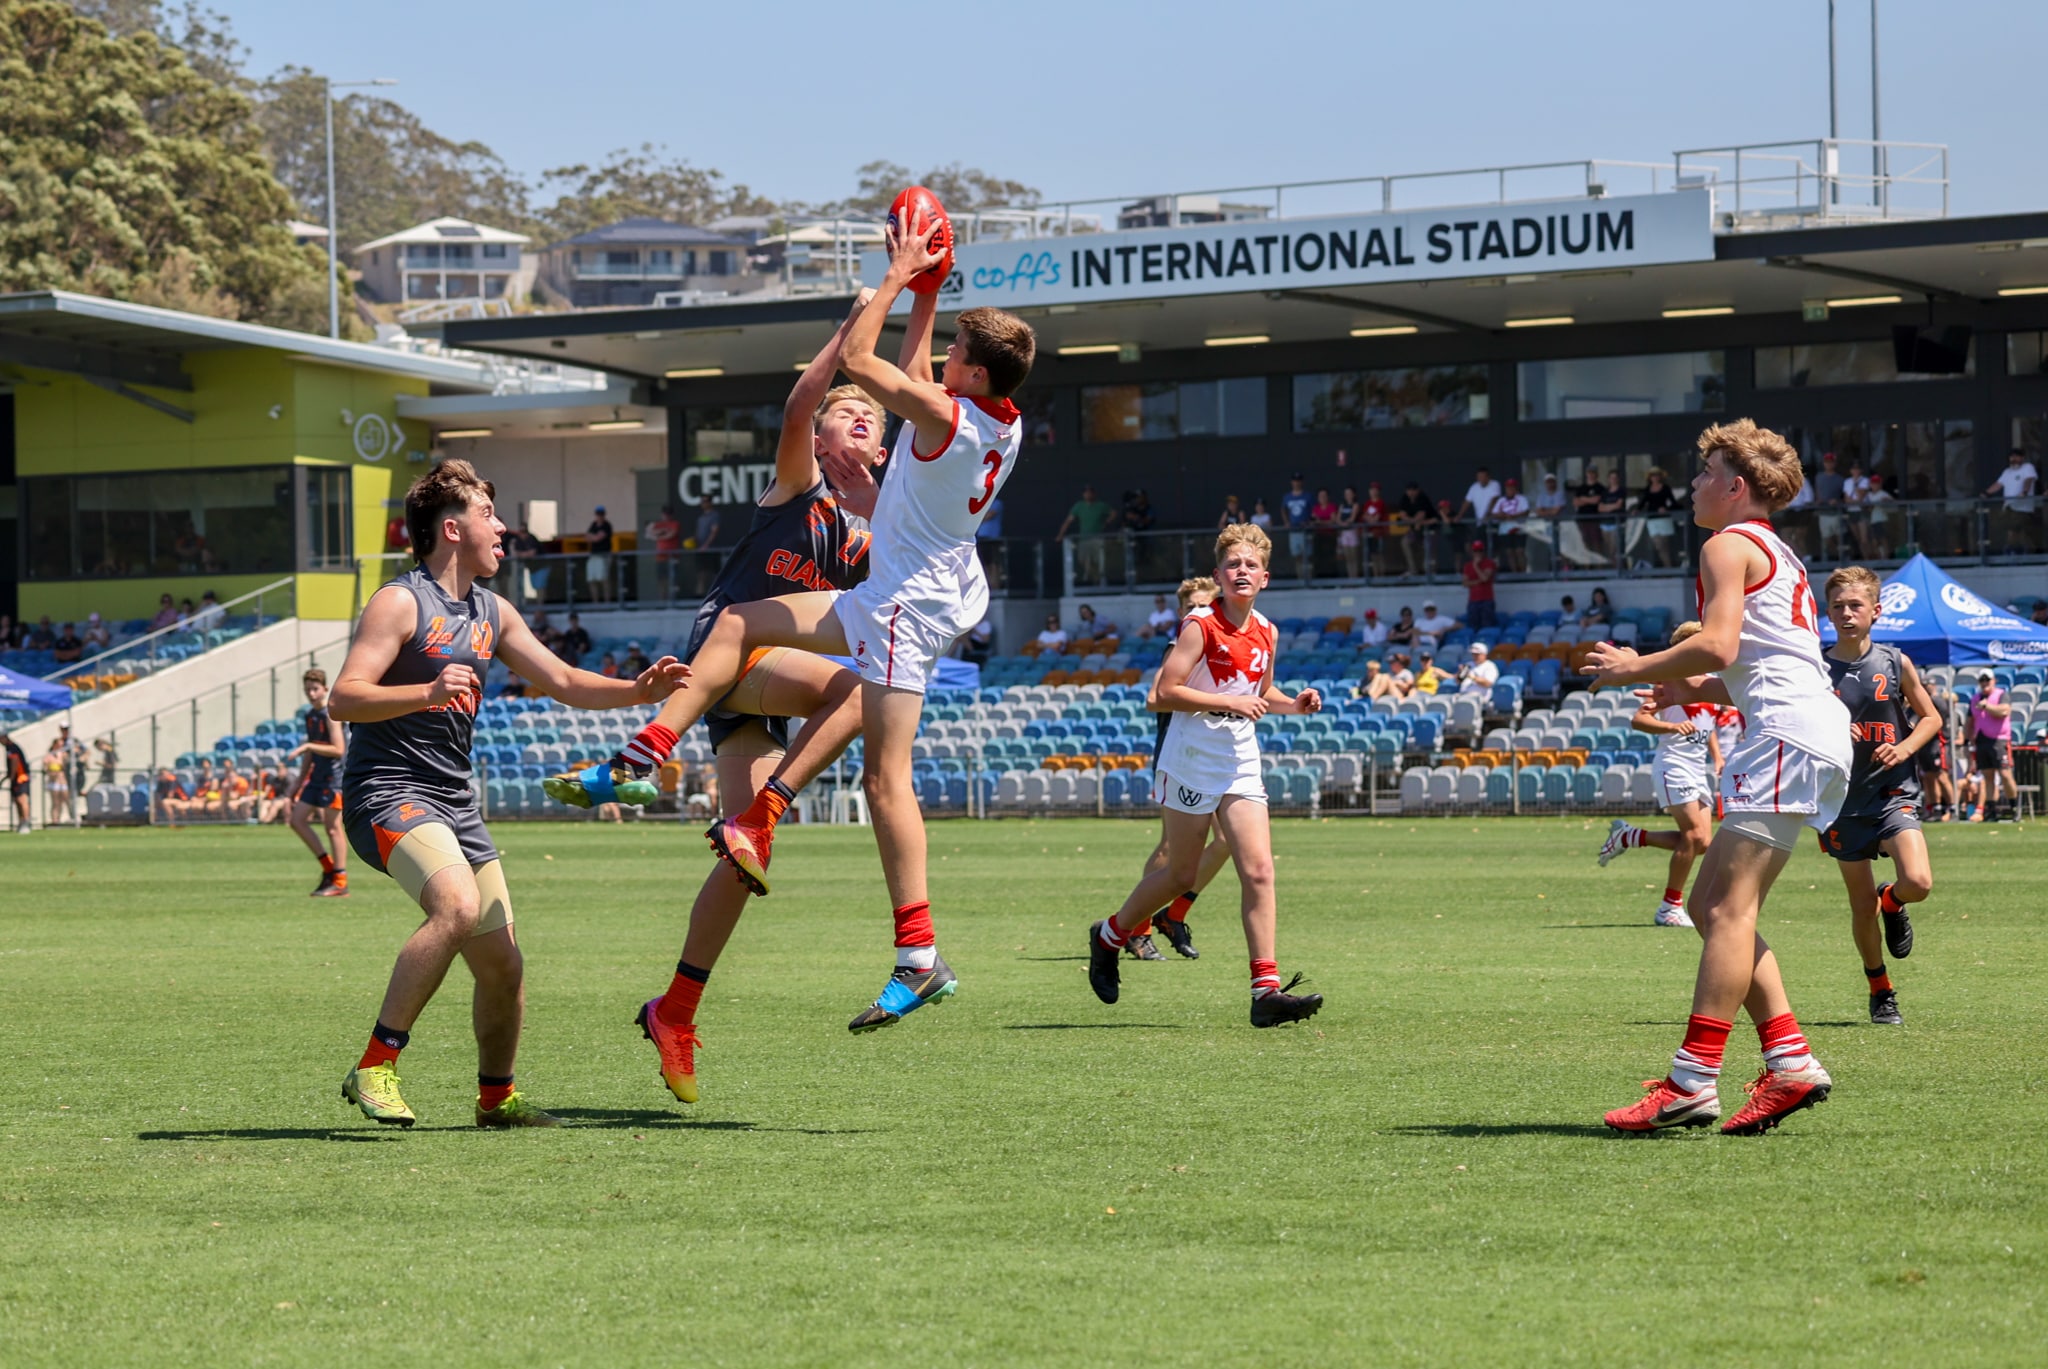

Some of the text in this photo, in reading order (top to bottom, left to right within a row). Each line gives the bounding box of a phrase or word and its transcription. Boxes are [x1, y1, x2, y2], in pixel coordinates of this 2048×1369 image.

[973, 251, 1062, 293] coffs
[1072, 226, 1414, 288] INTERNATIONAL
[1427, 209, 1634, 263] STADIUM
[968, 449, 1003, 515] 3
[837, 528, 873, 567] 27
[1872, 673, 1889, 701] 2
